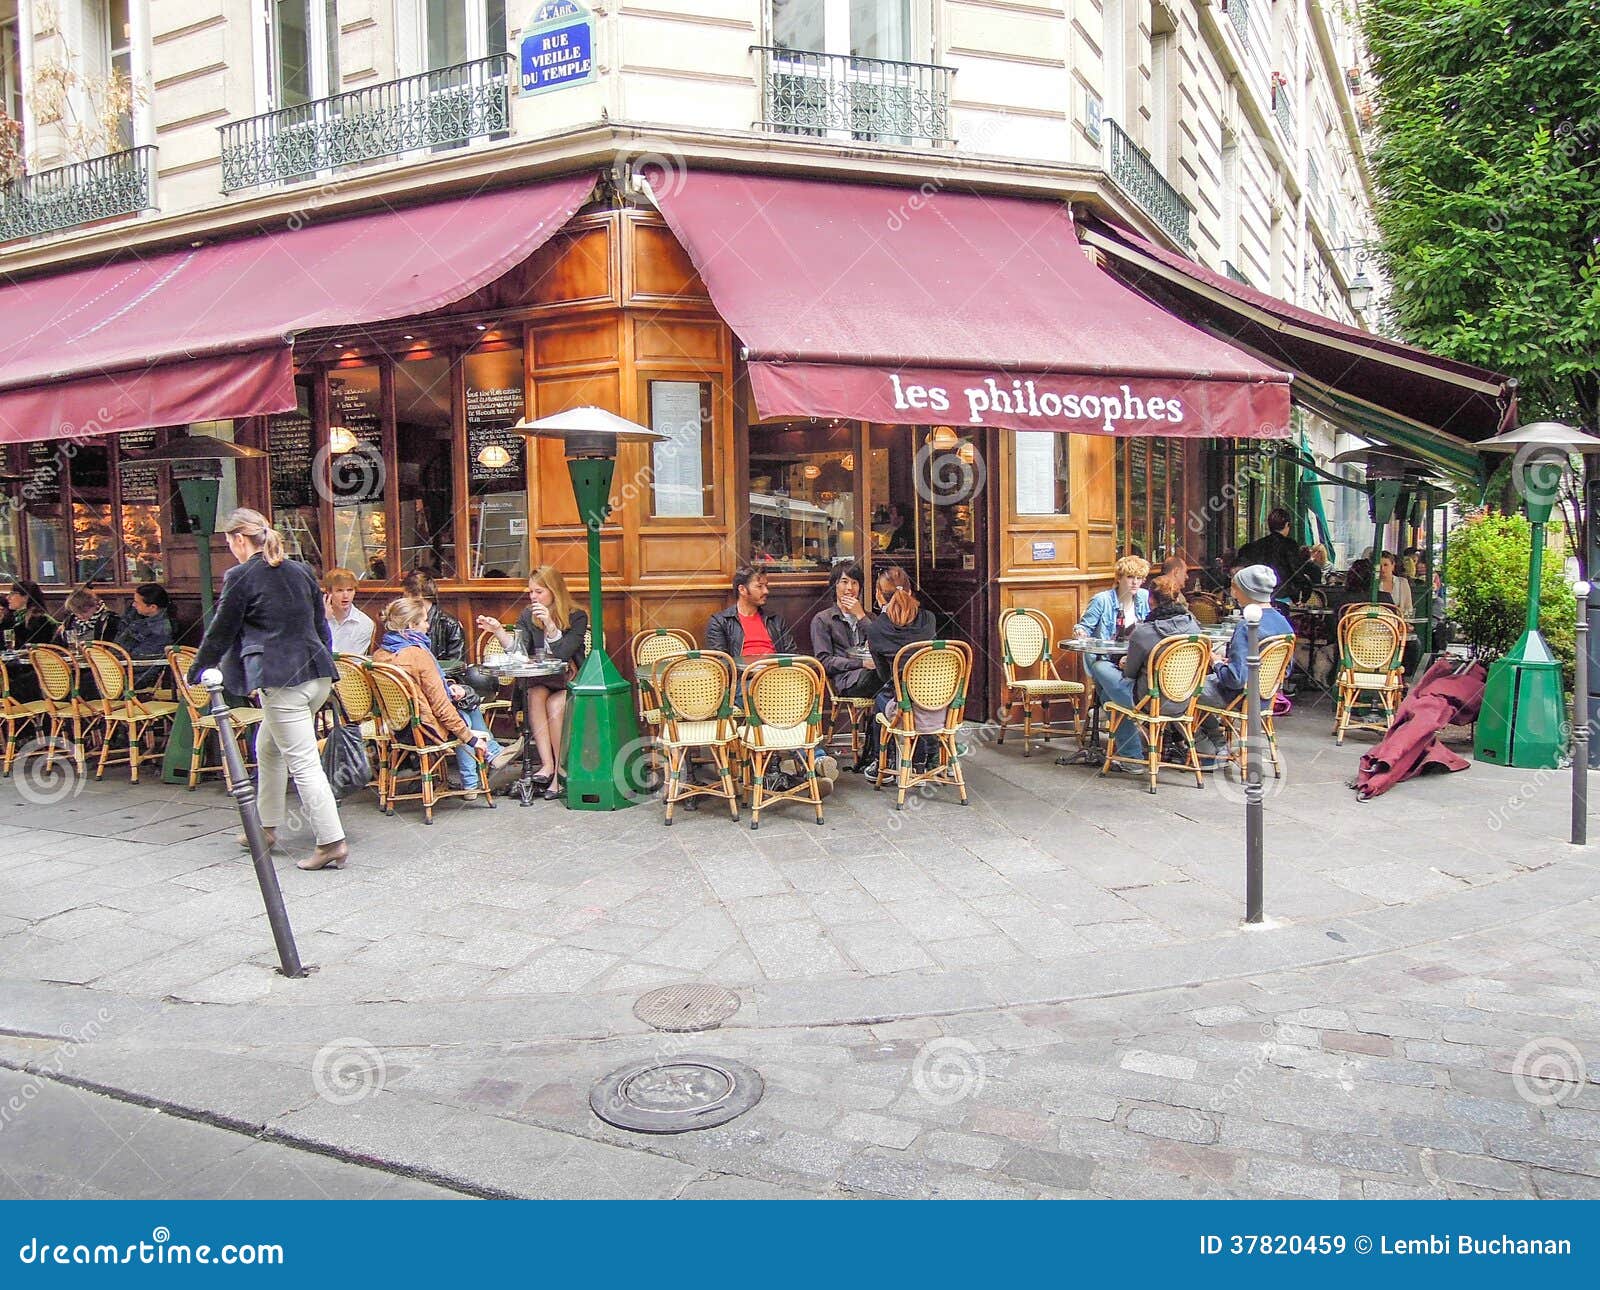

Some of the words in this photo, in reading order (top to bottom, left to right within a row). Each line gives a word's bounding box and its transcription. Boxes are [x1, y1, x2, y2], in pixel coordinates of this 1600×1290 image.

[543, 33, 569, 51] RUE
[531, 46, 581, 68] VIEILLE
[522, 72, 538, 86] DU
[542, 59, 591, 81] TEMPLE
[890, 374, 950, 411] les
[964, 378, 1184, 431] philosophes
